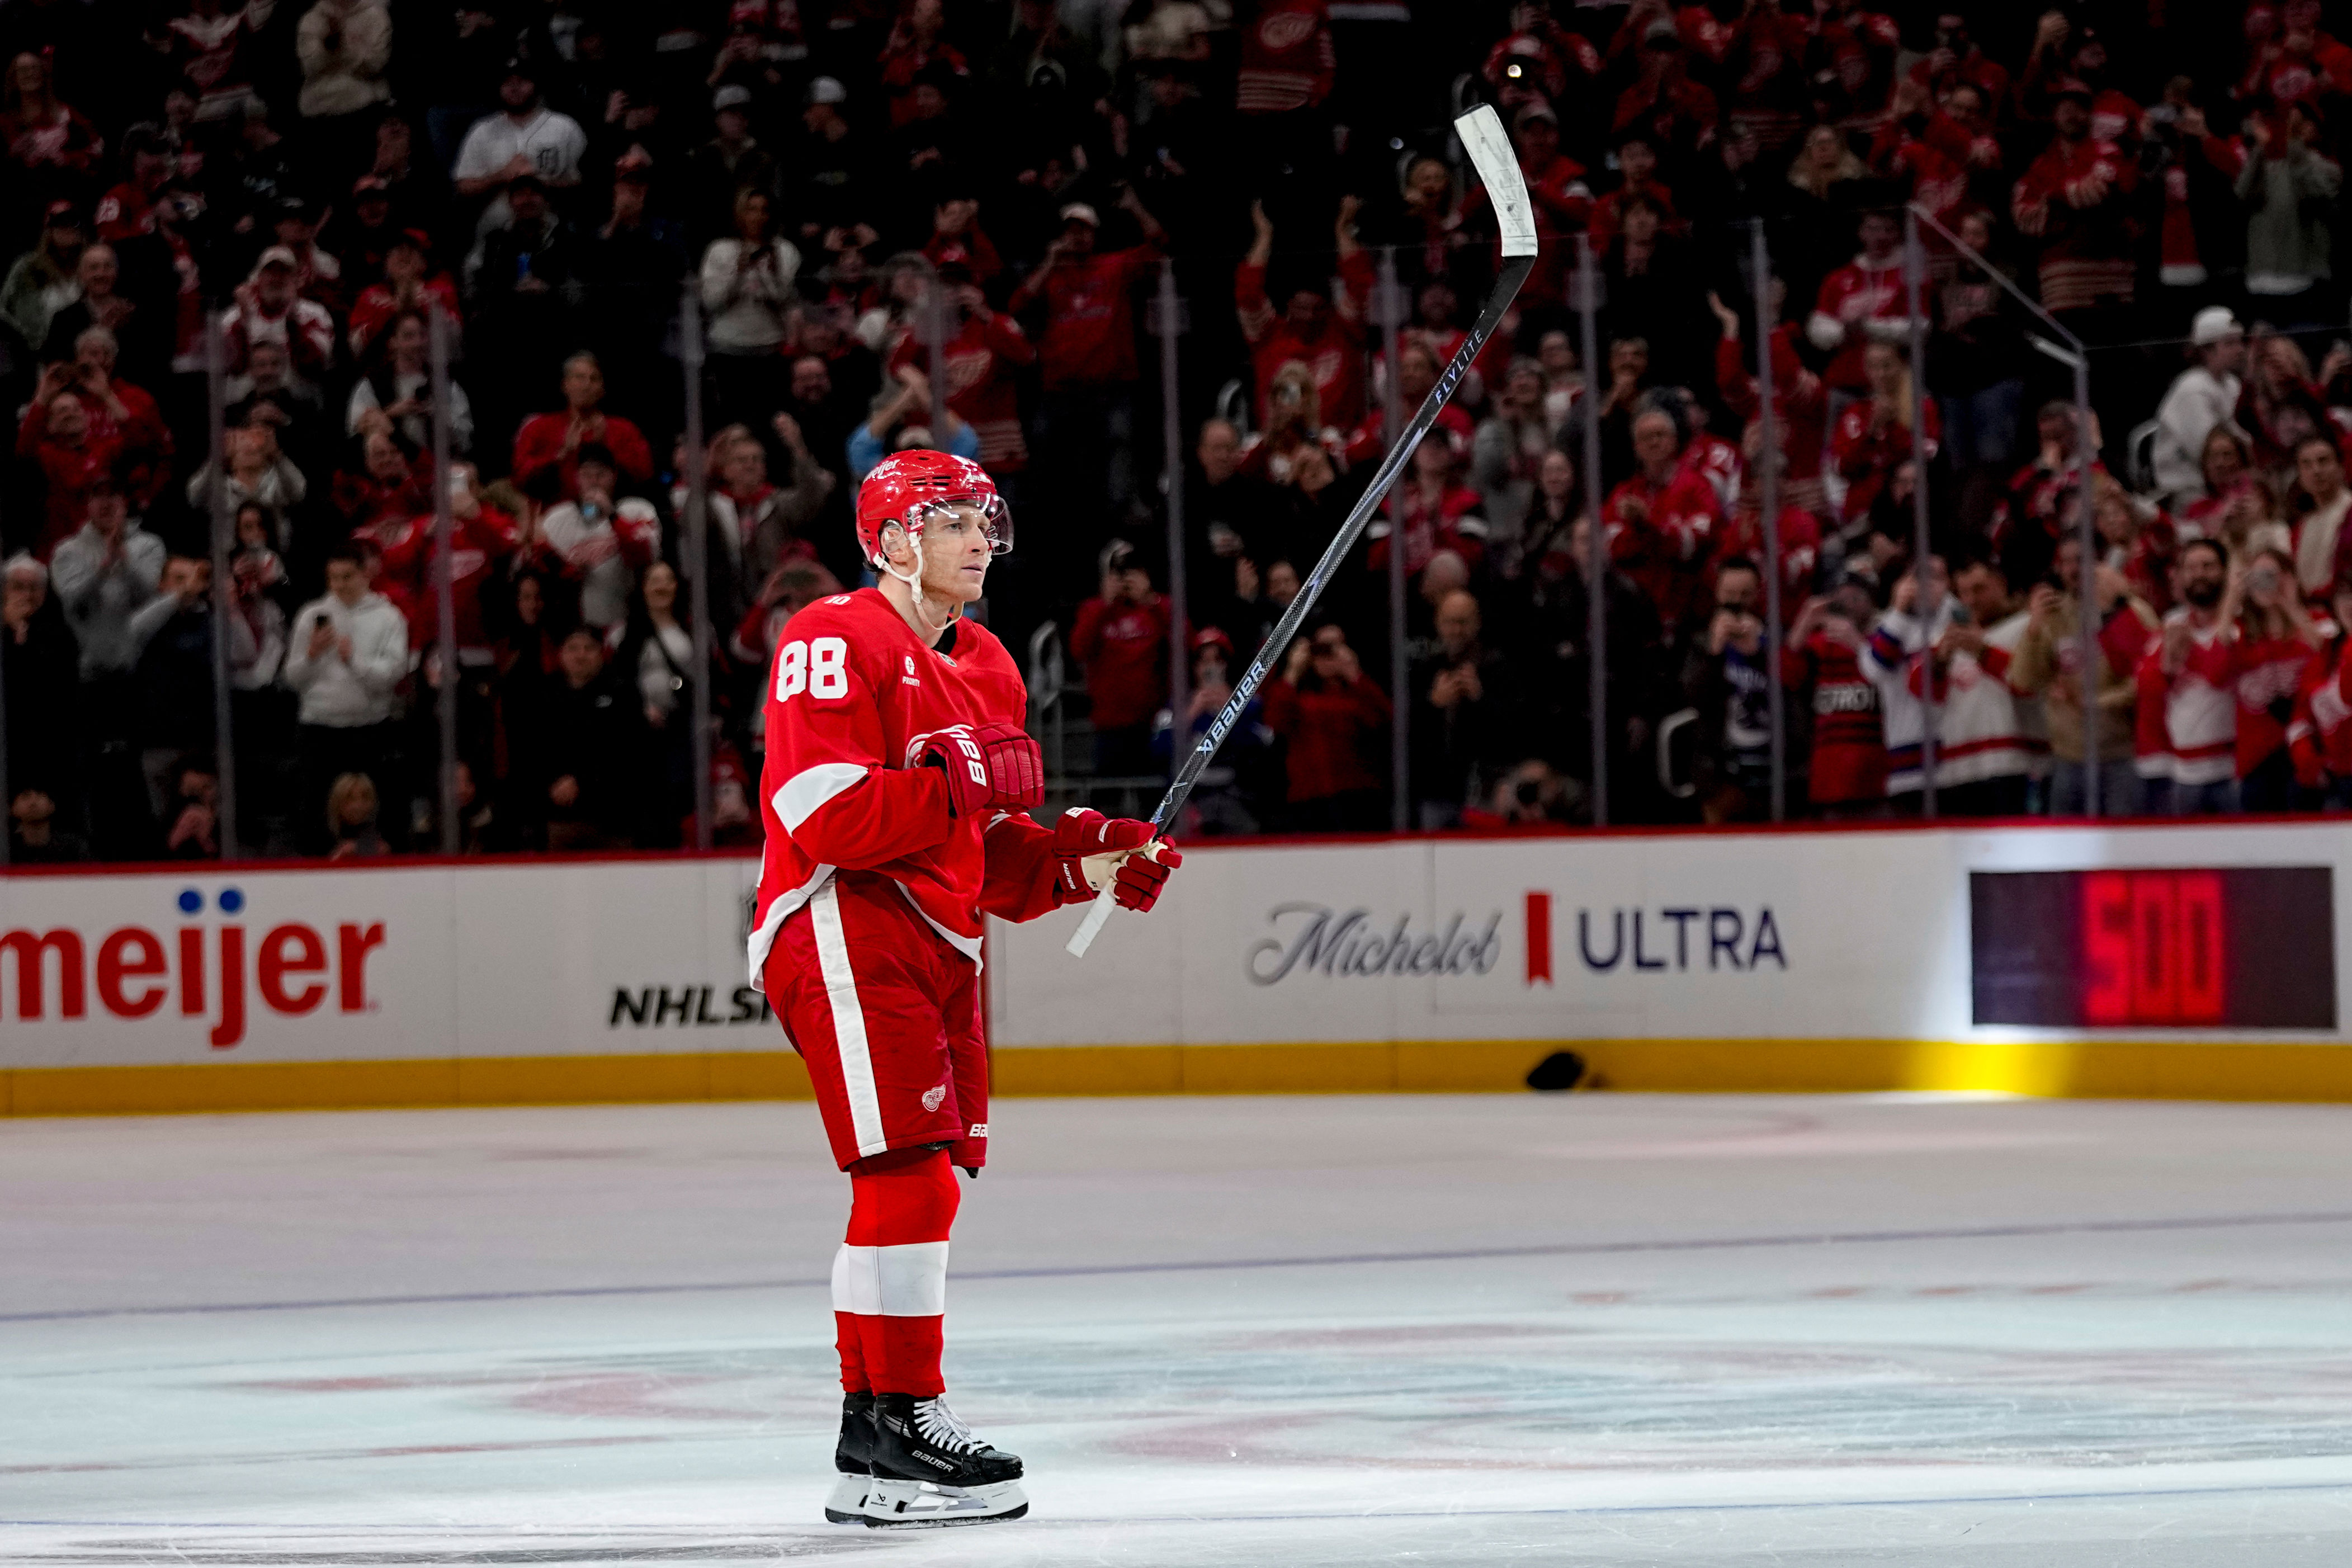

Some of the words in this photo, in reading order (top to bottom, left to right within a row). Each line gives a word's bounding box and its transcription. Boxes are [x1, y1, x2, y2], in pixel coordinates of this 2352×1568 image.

[1435, 329, 1483, 405] FLYLITE
[776, 637, 849, 703] 88
[1211, 661, 1265, 742] BAUER
[0, 889, 387, 1050] meijer
[1243, 900, 1503, 986] Michelob
[1578, 905, 1788, 972] ULTRA
[2081, 870, 2222, 1023] 500
[911, 1449, 954, 1472] BAUER
